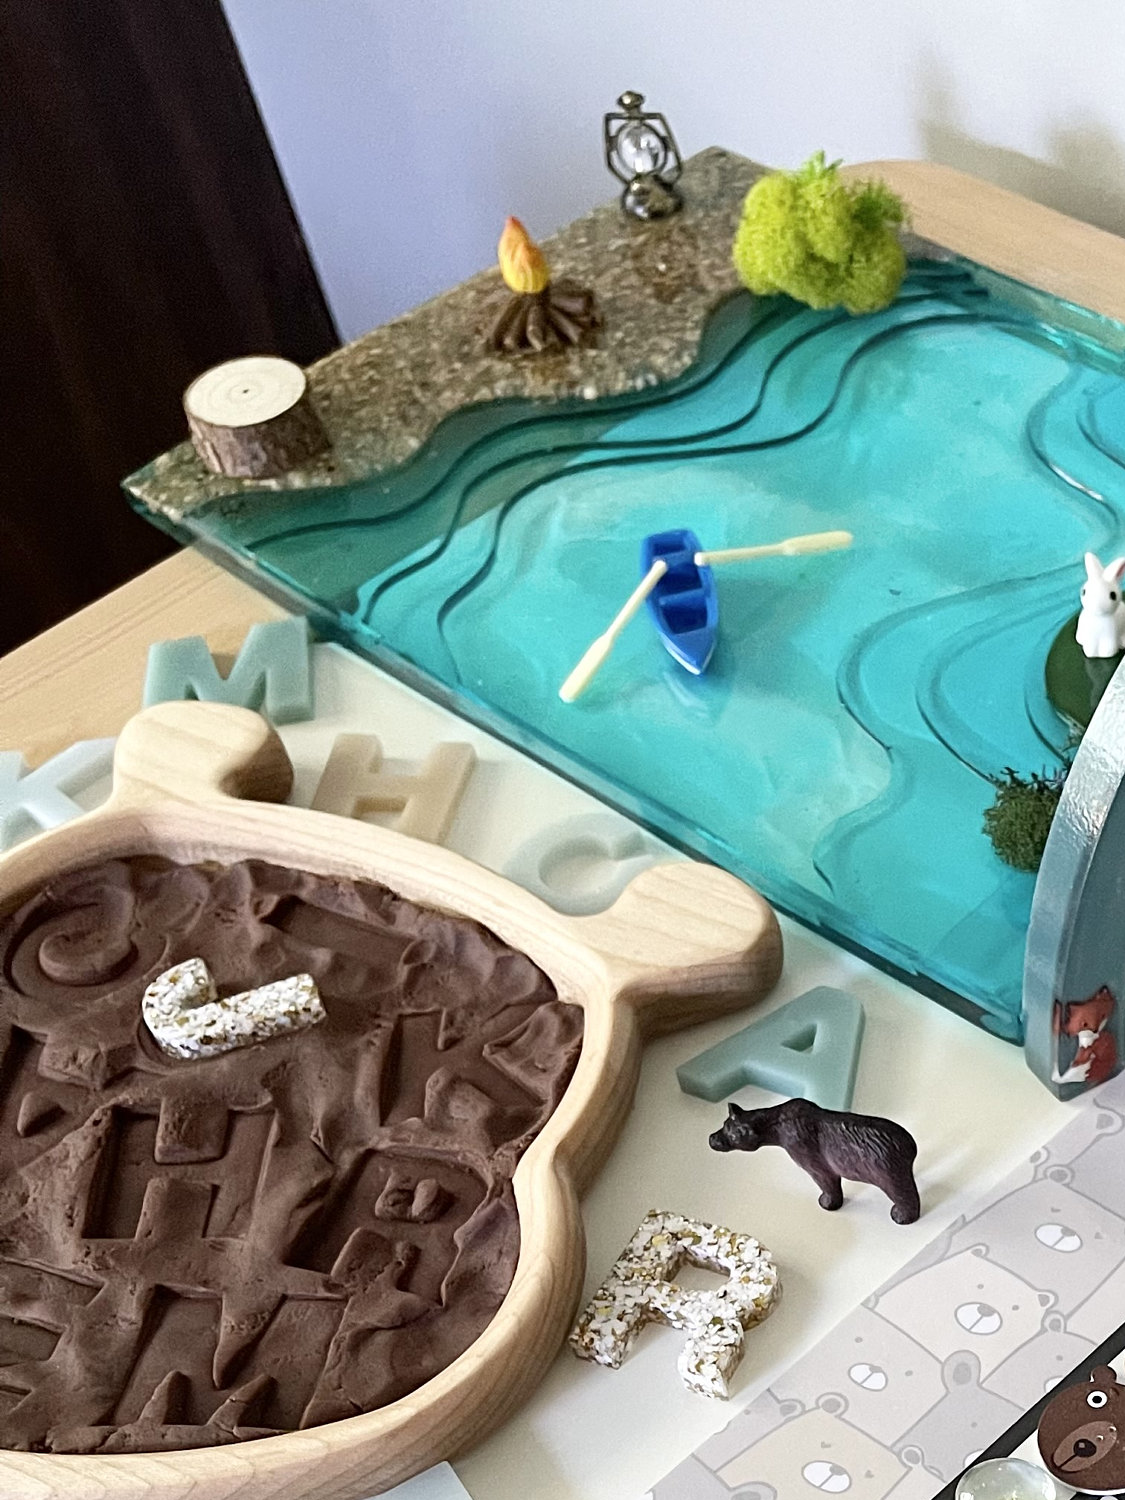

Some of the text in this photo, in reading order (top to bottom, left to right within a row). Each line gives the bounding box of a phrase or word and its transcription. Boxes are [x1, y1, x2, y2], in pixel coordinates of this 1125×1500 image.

[142, 616, 314, 725] M
[313, 733, 477, 846] H
[676, 985, 866, 1112] A
[568, 1208, 782, 1402] R
